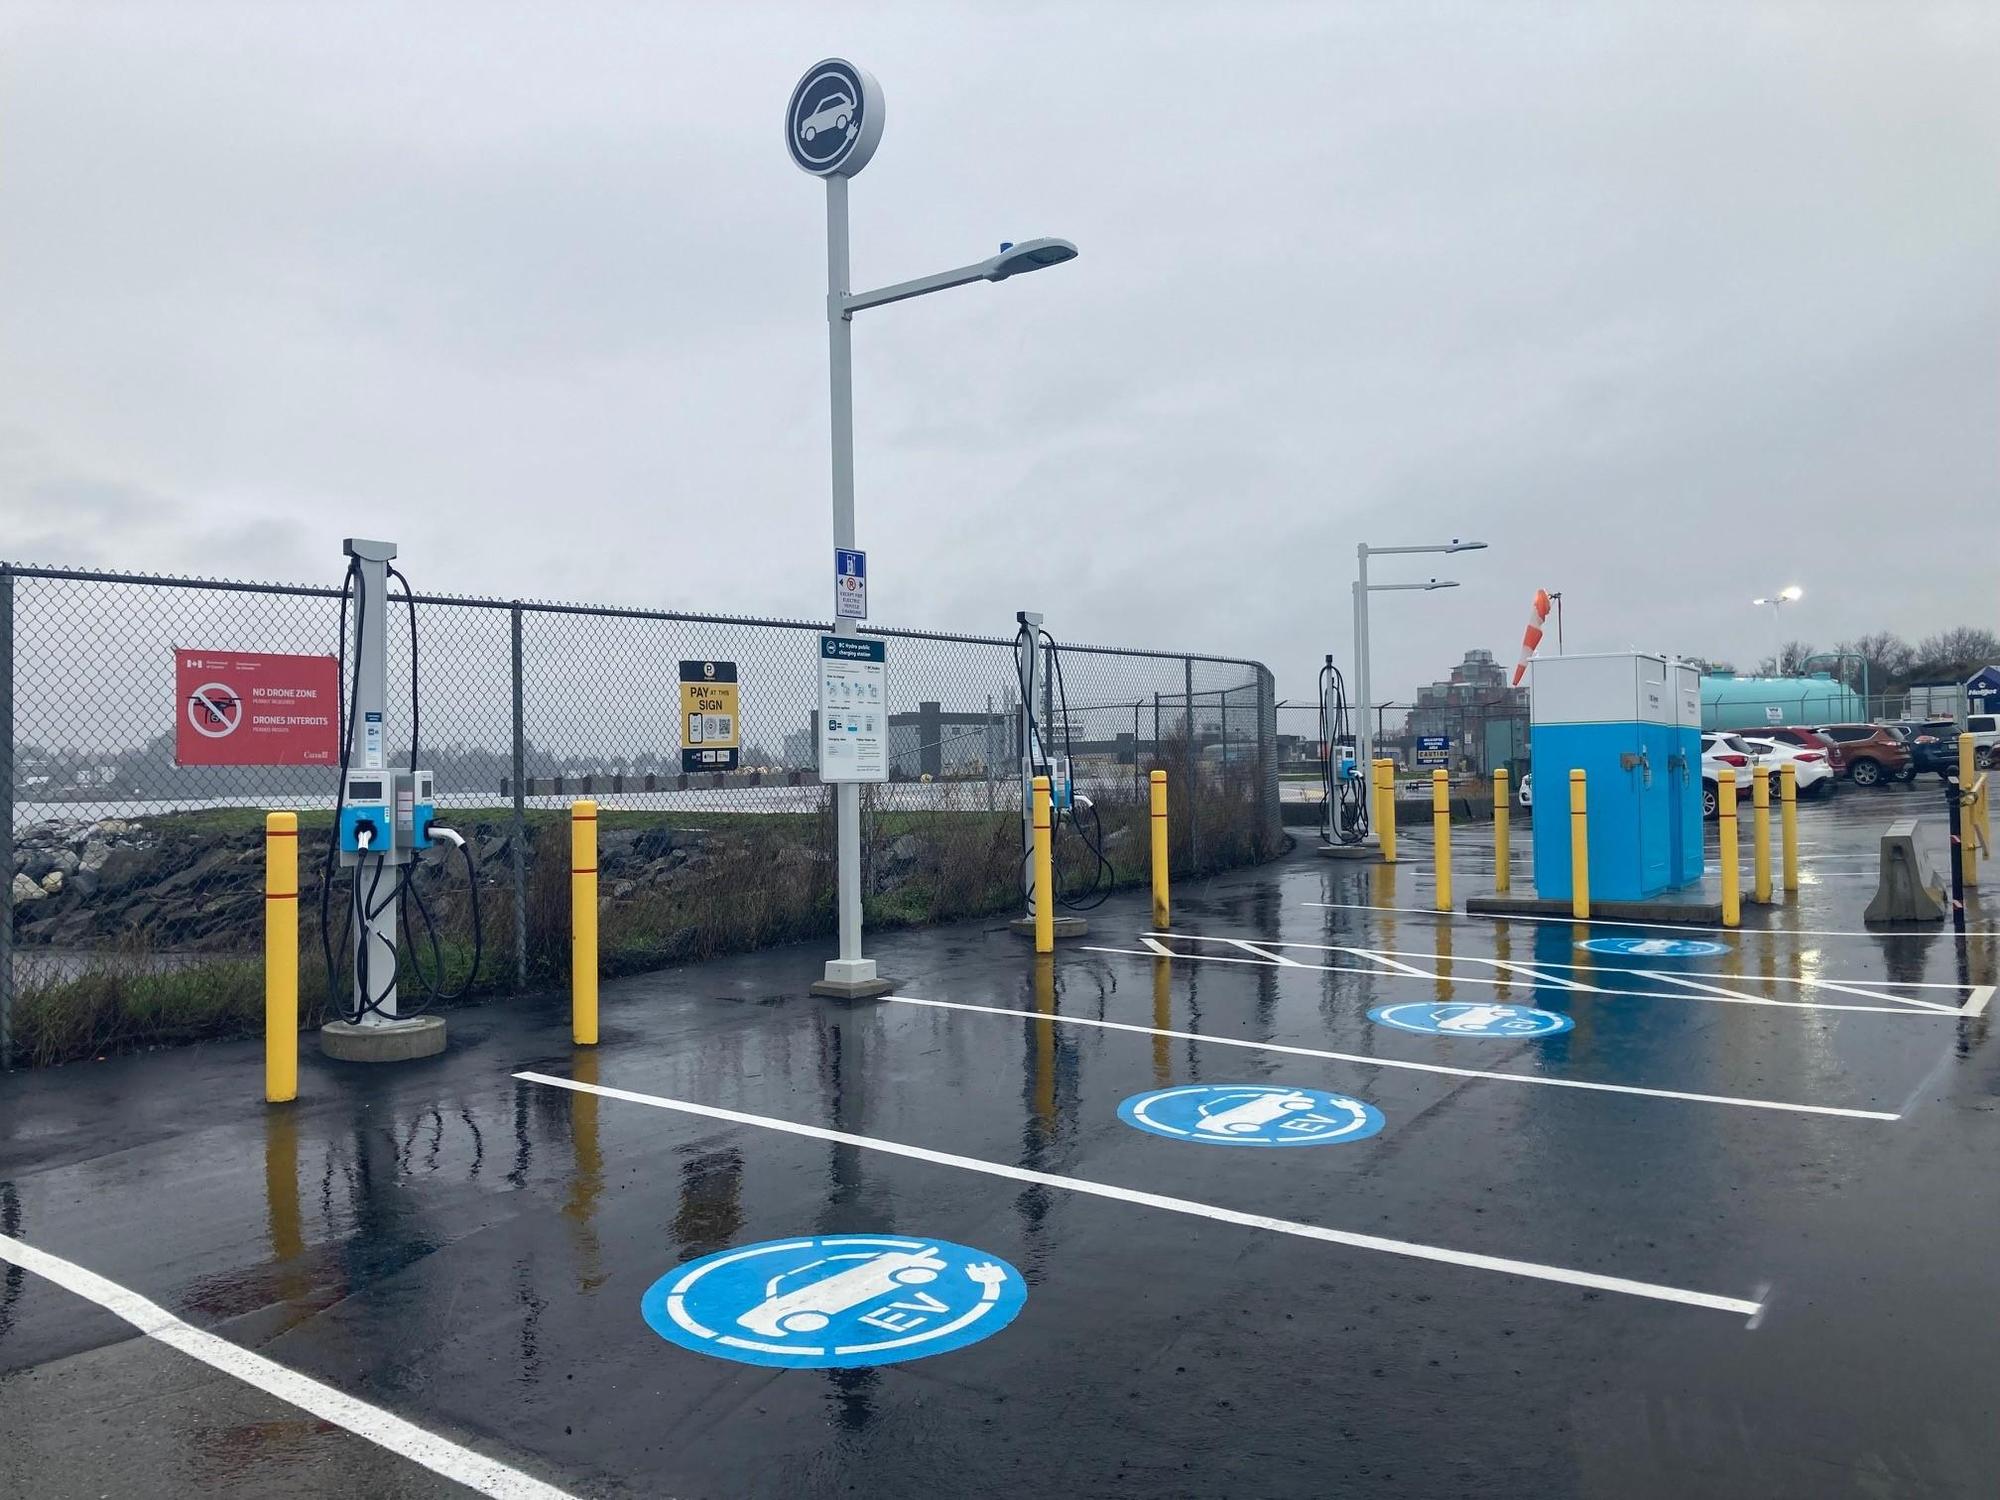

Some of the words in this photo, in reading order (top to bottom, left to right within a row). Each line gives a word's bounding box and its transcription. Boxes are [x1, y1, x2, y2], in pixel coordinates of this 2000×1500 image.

[253, 688, 265, 696] NO
[267, 689, 295, 697] DRONE
[296, 690, 317, 698] ZONE
[690, 686, 709, 698] PAY
[699, 700, 722, 710] SIGN
[253, 716, 286, 724] DRONES
[287, 717, 328, 725] INTERDITS
[1279, 1113, 1338, 1132] EV
[857, 1292, 951, 1333] EV
